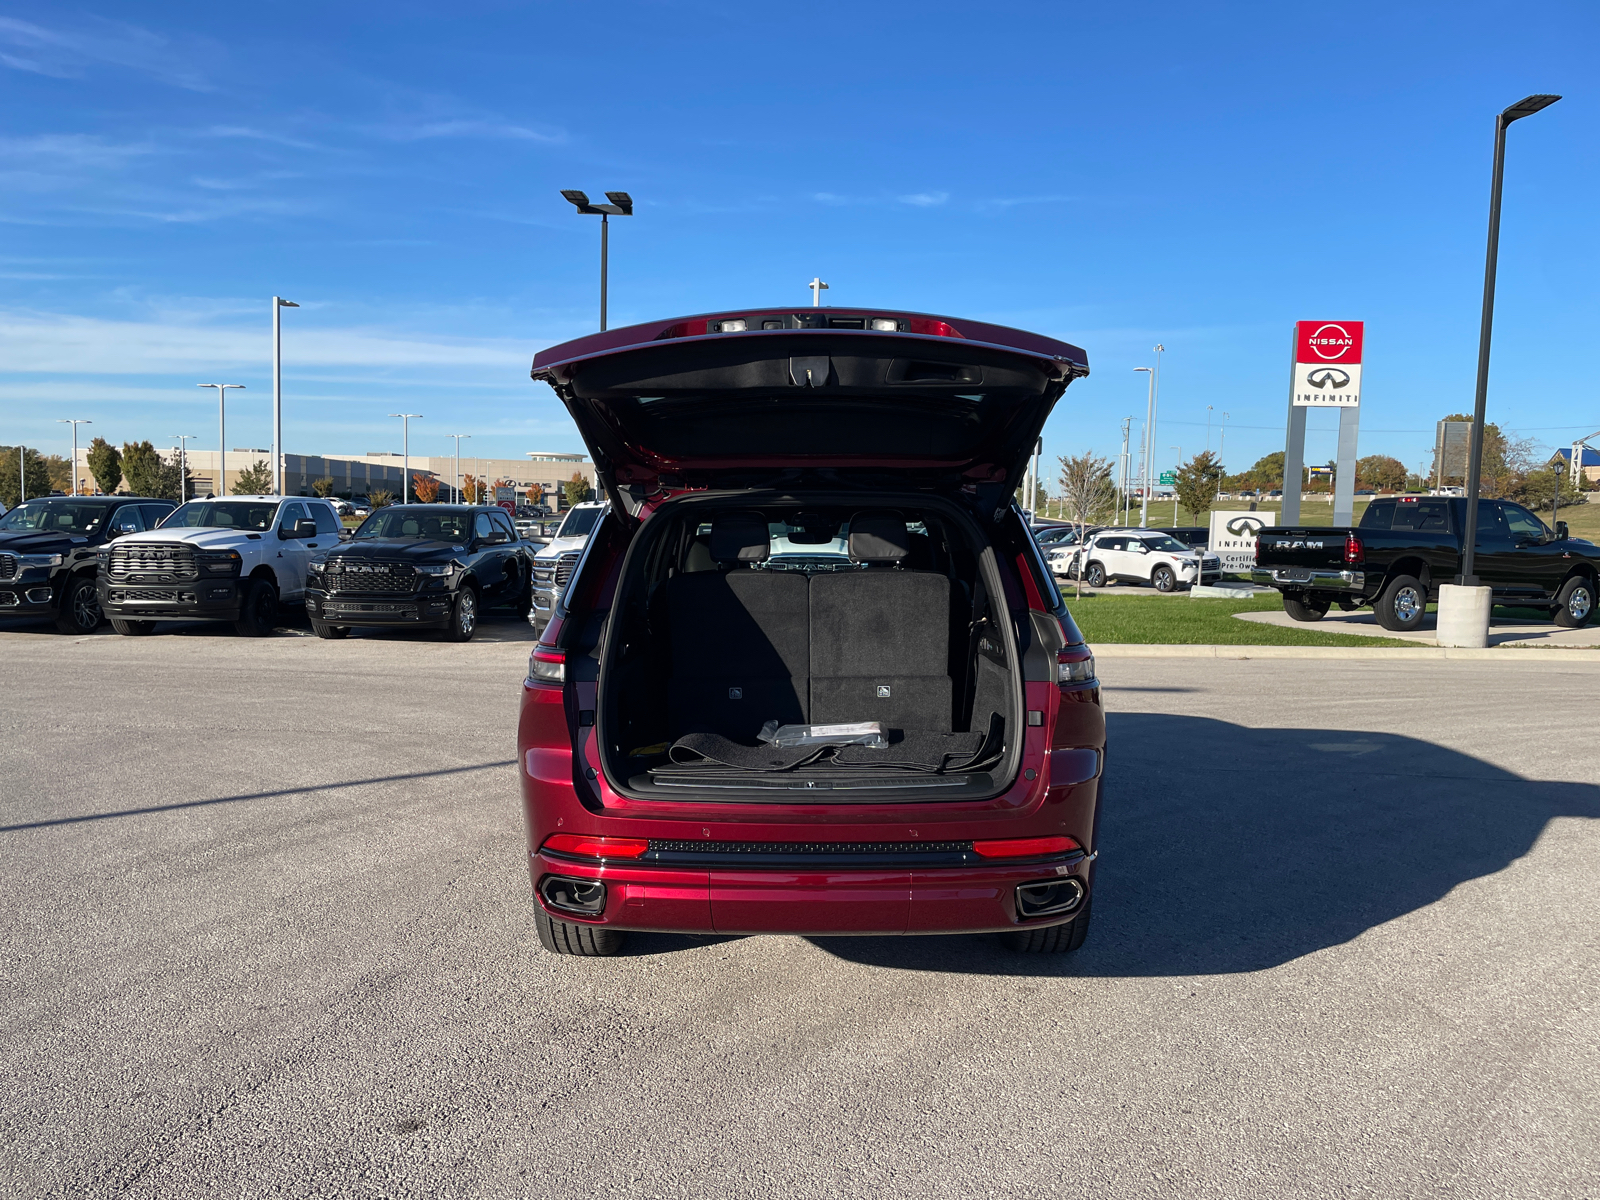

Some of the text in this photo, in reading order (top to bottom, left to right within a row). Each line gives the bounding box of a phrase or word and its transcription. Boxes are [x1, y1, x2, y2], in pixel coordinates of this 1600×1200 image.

[1308, 338, 1353, 346] NISSAN
[1297, 394, 1358, 402] INFINITI
[1218, 540, 1257, 548] INFIN
[1276, 541, 1324, 549] RAM
[129, 550, 171, 559] RAM
